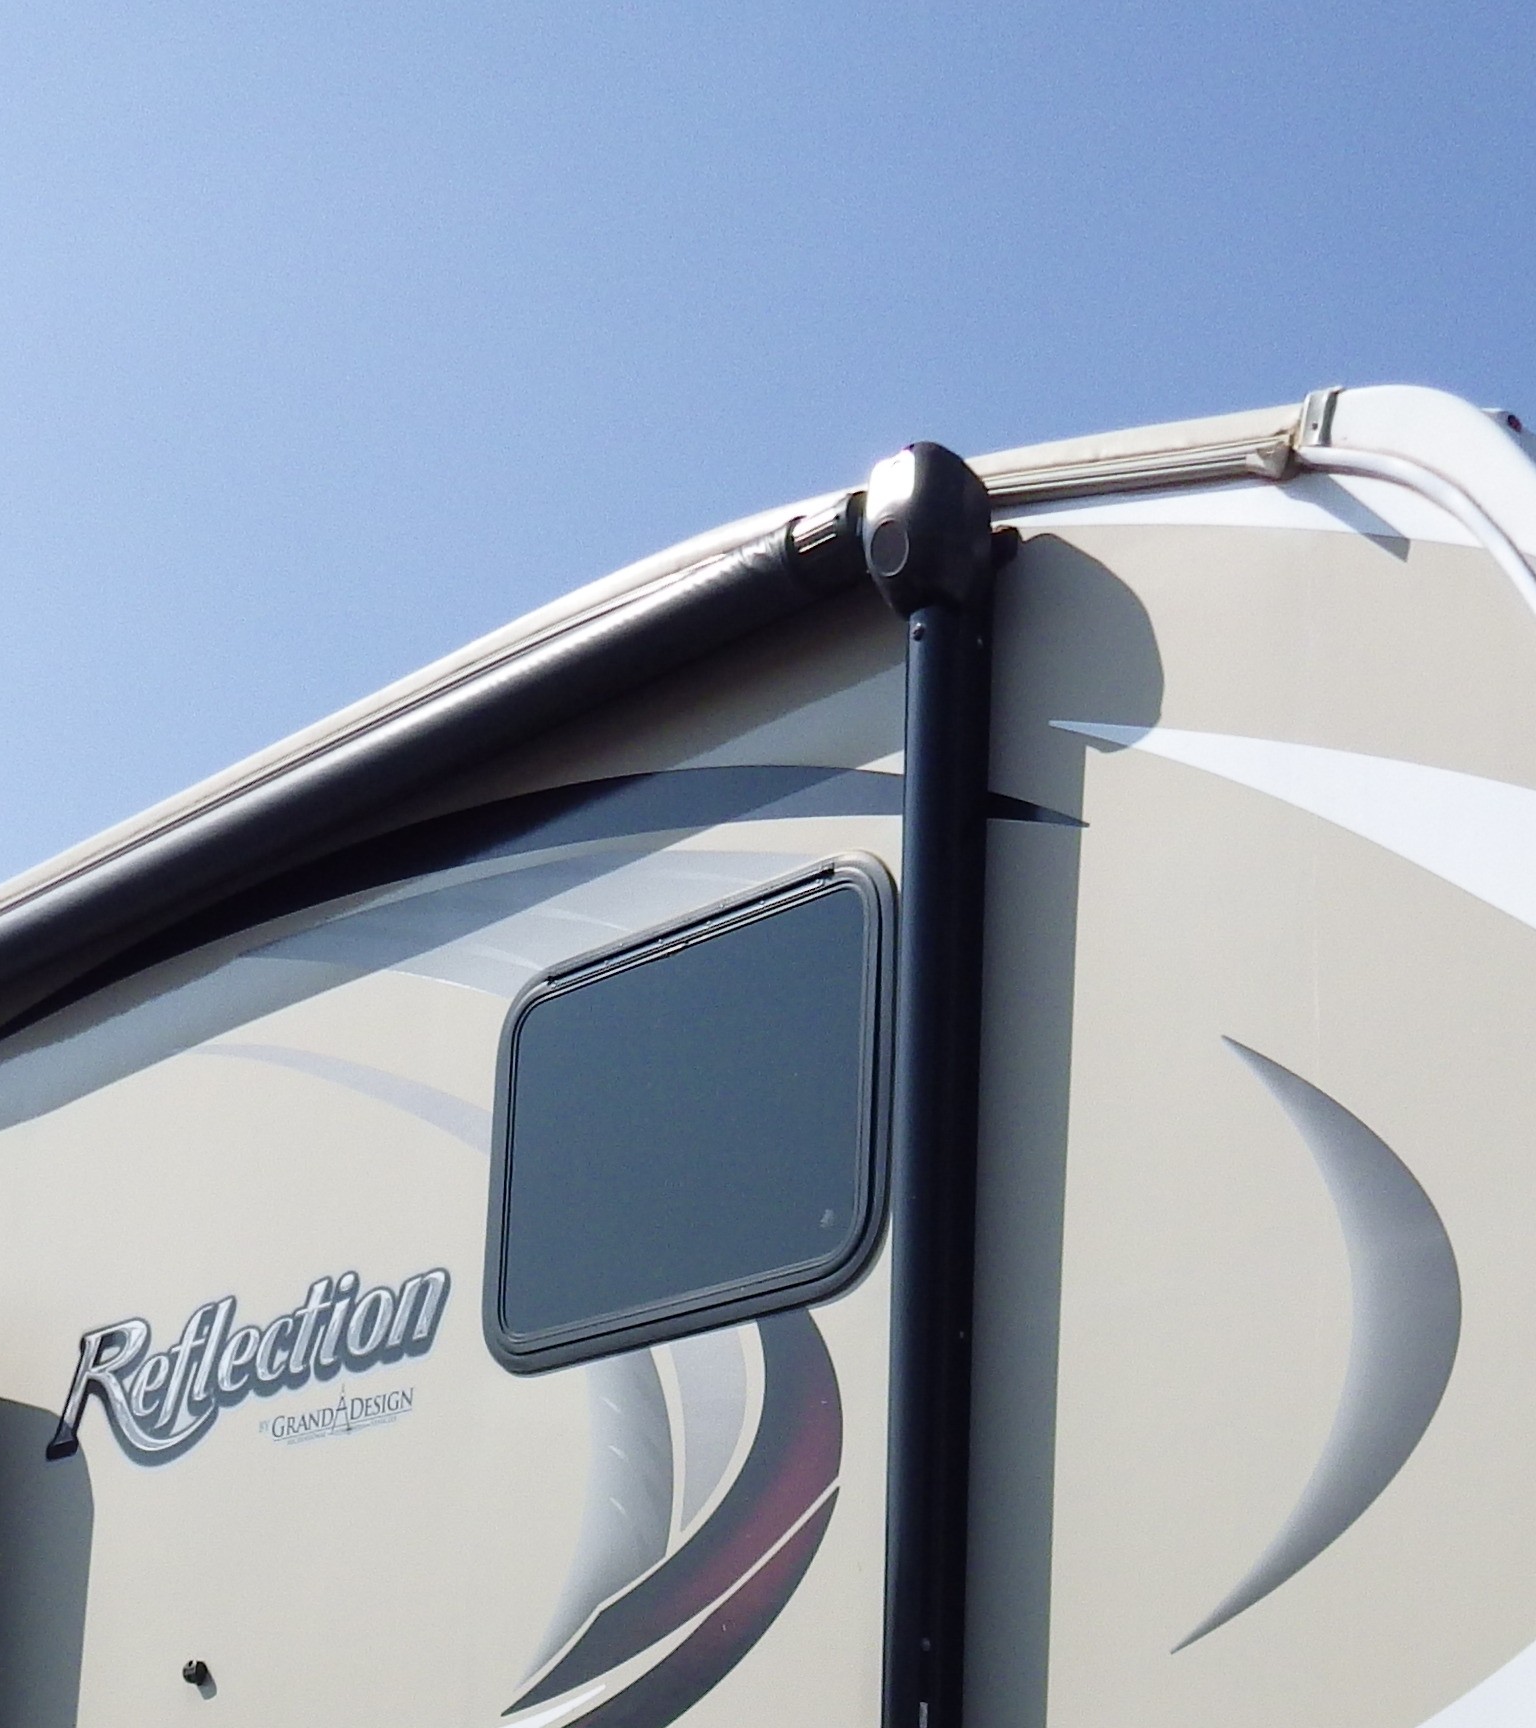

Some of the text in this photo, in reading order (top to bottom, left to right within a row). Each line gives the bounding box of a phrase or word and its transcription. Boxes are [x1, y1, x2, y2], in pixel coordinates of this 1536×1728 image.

[46, 1267, 451, 1467] Reflection
[271, 1407, 334, 1438] GRAND
[350, 1387, 414, 1421] DESIGN
